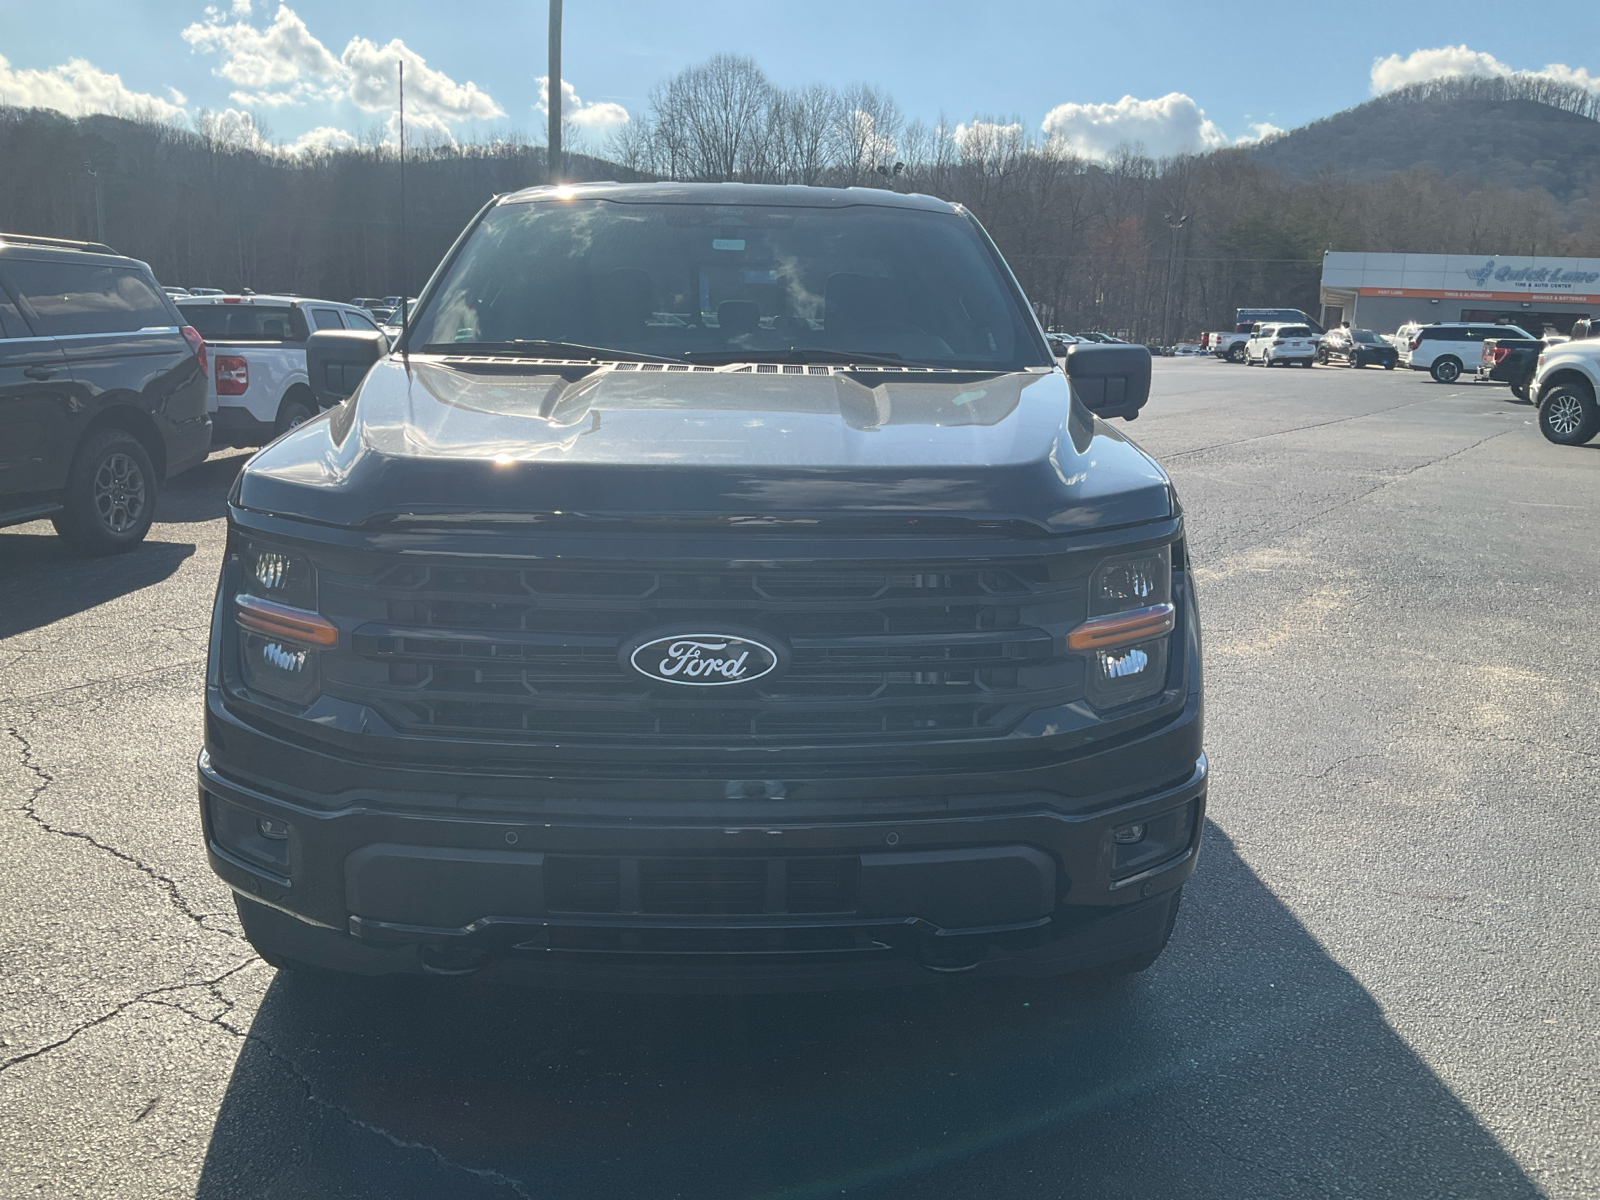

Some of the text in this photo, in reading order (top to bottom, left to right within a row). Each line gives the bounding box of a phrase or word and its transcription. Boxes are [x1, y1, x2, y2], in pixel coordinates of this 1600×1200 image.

[1495, 265, 1600, 283] Quick Lane
[659, 640, 749, 677] Ford
